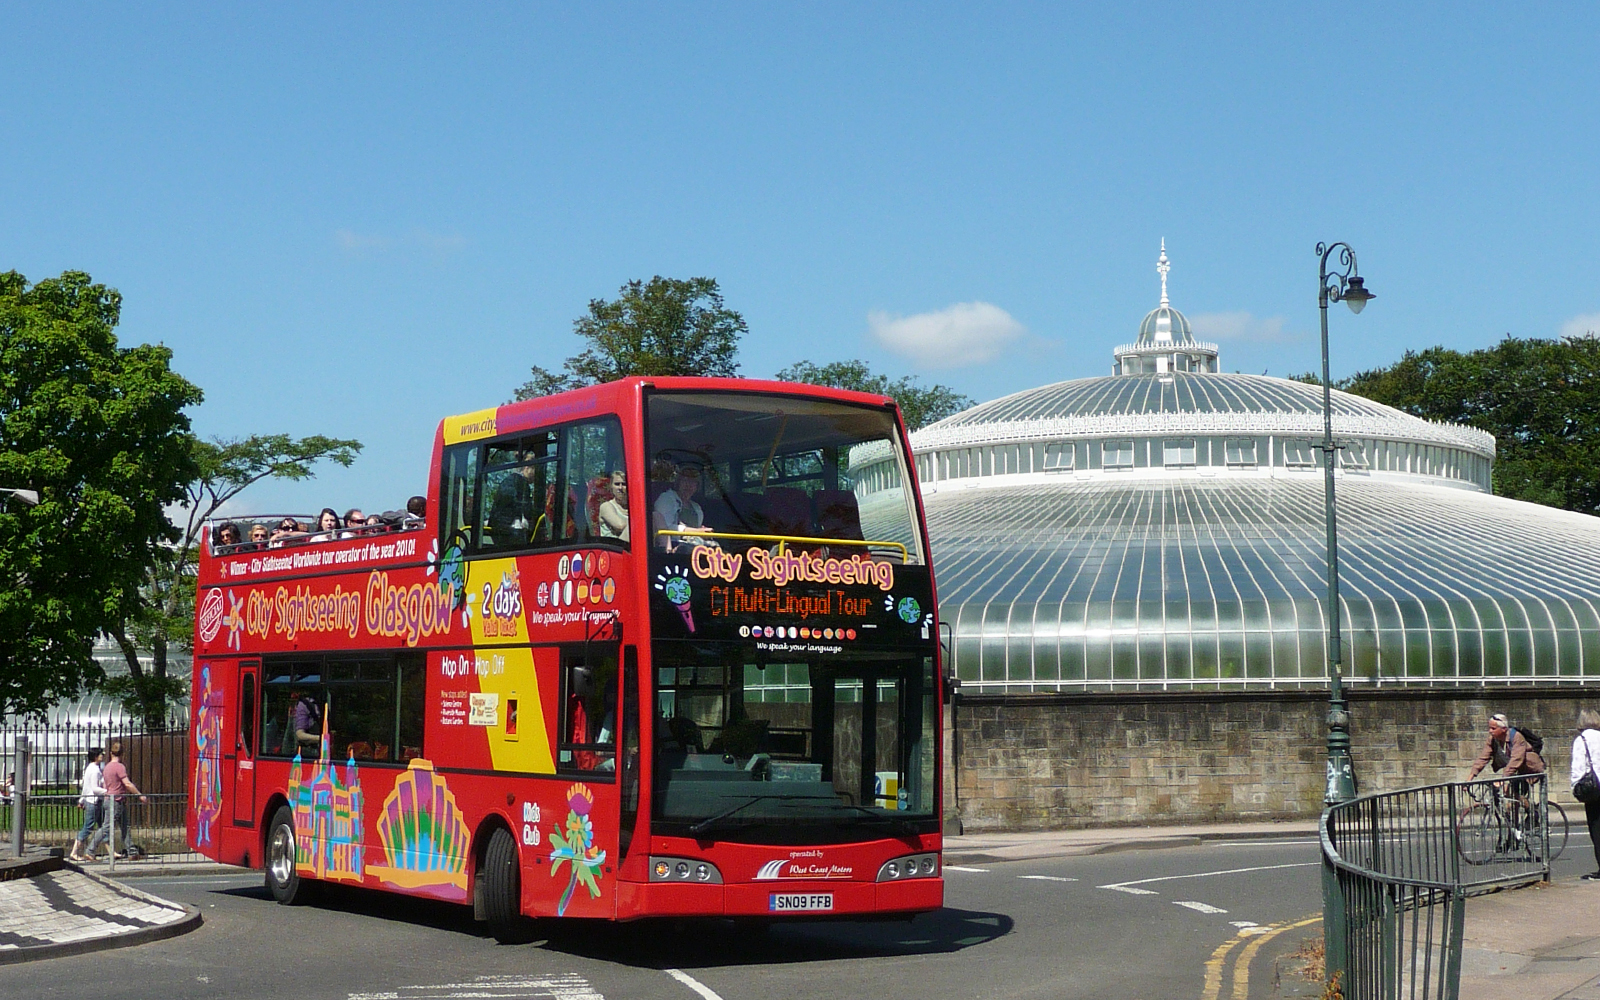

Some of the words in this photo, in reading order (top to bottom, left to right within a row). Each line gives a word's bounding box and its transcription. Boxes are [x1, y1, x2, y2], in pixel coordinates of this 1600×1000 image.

[231, 562, 247, 575] Winner
[252, 559, 262, 573] City
[262, 555, 292, 572] Sightseeing
[293, 551, 321, 568] Worldwide
[322, 549, 335, 565] tour
[335, 546, 361, 563] operator
[362, 543, 369, 560] of
[370, 542, 379, 559] the
[380, 543, 395, 559] year
[396, 538, 416, 556] 2010!
[691, 545, 742, 582] City
[747, 547, 894, 591] Sightseeing
[247, 588, 274, 640] City
[275, 584, 360, 641] Sightseeing
[366, 569, 454, 647] Glasgow
[482, 583, 492, 616] 2
[494, 583, 521, 618] days
[734, 587, 831, 620] Multi-Lingual
[836, 590, 873, 616] Tour
[200, 599, 222, 630] OFFICIAL
[532, 610, 543, 624] We
[543, 608, 563, 627] speak
[563, 612, 581, 626] your
[768, 642, 789, 652] speak
[789, 644, 807, 652] your
[807, 643, 842, 653] language
[442, 656, 457, 679] Hop
[458, 654, 469, 676] On
[474, 656, 489, 678] Hop
[492, 654, 505, 675] Off
[523, 802, 540, 822] Kids
[523, 824, 540, 846] Club
[790, 850, 816, 859] operated
[817, 850, 824, 858] by
[790, 865, 807, 873] West
[809, 865, 828, 873] Coast
[826, 864, 853, 876] Motors
[778, 896, 807, 908] SN09
[811, 896, 831, 908] FFB
